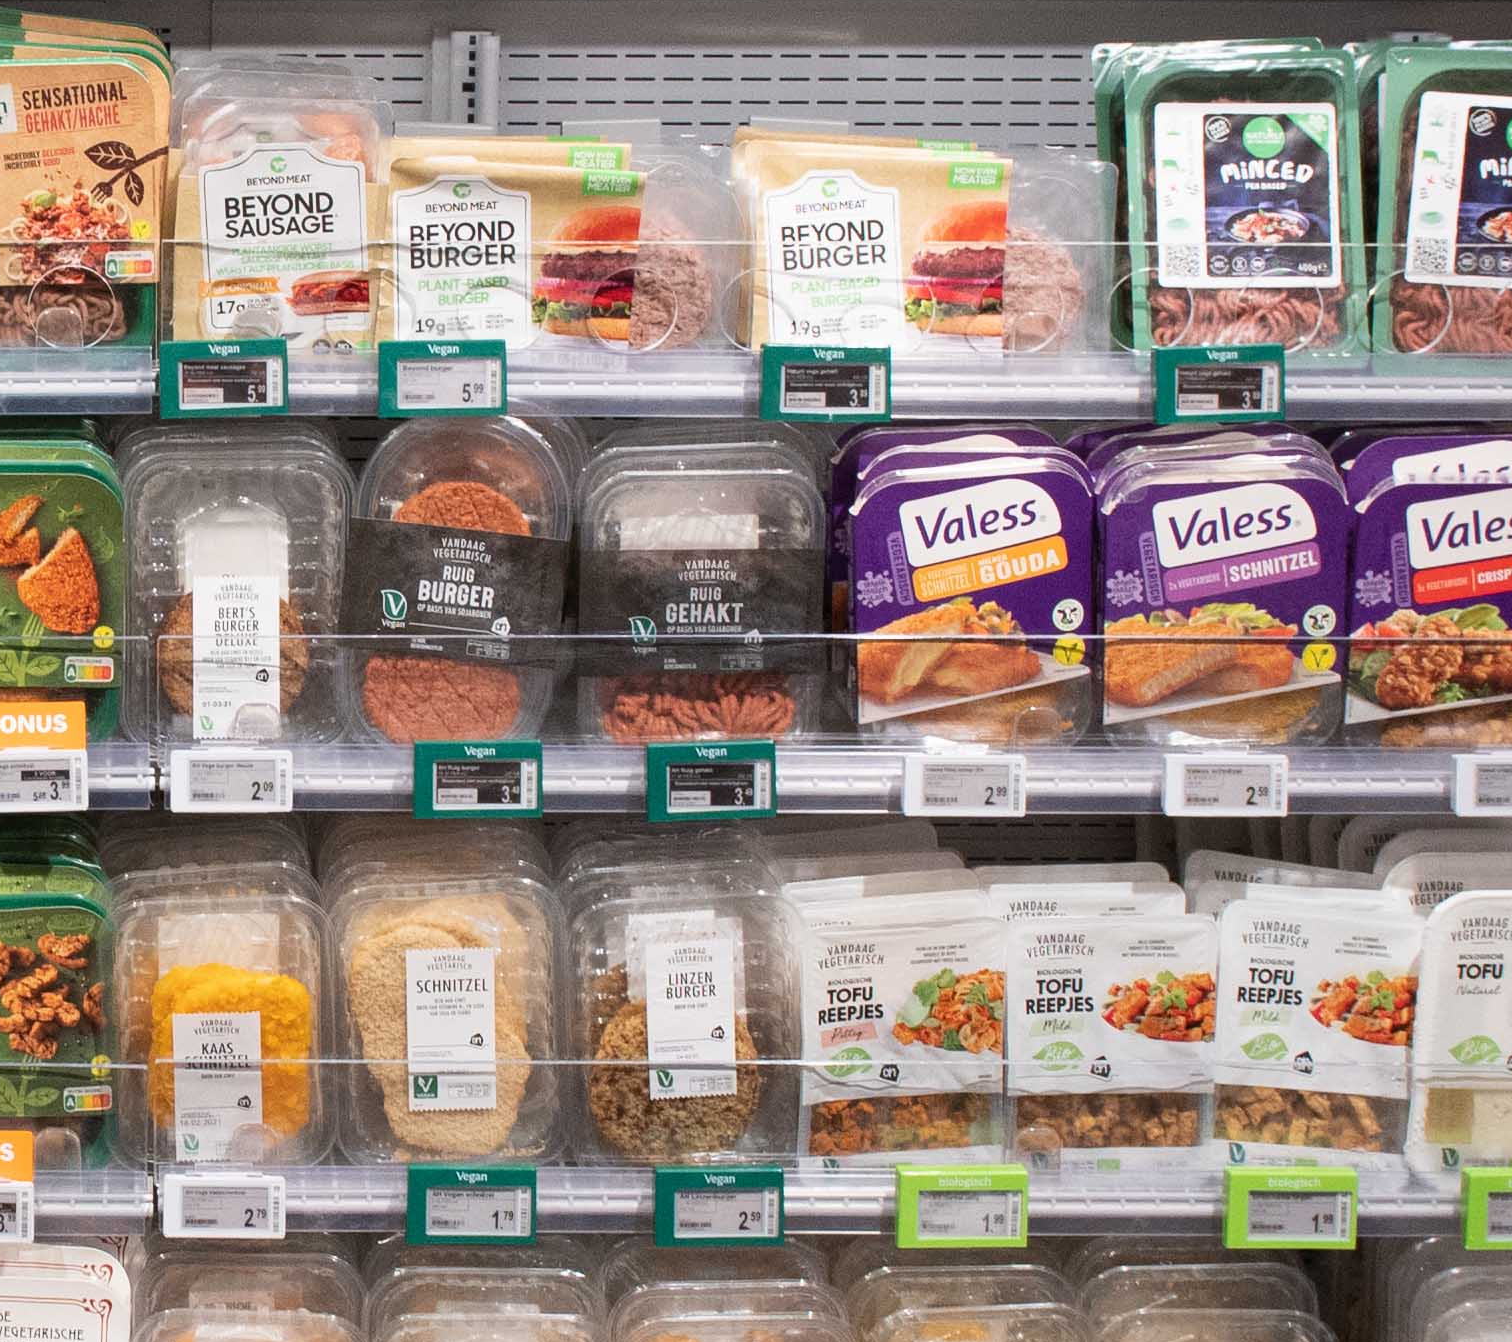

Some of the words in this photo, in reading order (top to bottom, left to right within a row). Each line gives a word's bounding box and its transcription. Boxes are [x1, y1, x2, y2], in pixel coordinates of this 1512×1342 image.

[246, 176, 284, 186] BEYOND
[287, 175, 311, 184] MEAT
[224, 193, 333, 218] BEYOND
[425, 201, 467, 213] BEYOND
[470, 200, 497, 212] MEAT
[225, 215, 334, 238] SAUSAGE
[410, 222, 515, 244] BEYOND
[410, 243, 516, 269] BURGER
[418, 276, 509, 292] PLANT-BASED
[428, 343, 460, 356] Vegan
[914, 495, 1037, 550] Valess
[441, 536, 486, 552] VANDAAG
[433, 546, 492, 564] VEGETARISCH
[442, 565, 475, 583] RUIG
[979, 549, 1061, 584] GOUDA
[1229, 552, 1318, 583] SCHNITZEL
[417, 579, 494, 609] BURGER
[665, 601, 744, 626] GEHAKT
[214, 618, 259, 634] BURGER
[827, 944, 875, 957] VANDAAG
[818, 954, 885, 970] VEGETARISCH
[416, 978, 488, 994] SCHNITZEL
[668, 970, 713, 986] LINZEN
[665, 984, 716, 999] BURGER
[827, 987, 874, 1005] TOFU
[817, 1004, 884, 1026] REEPJES
[938, 1176, 992, 1190] biologisch
